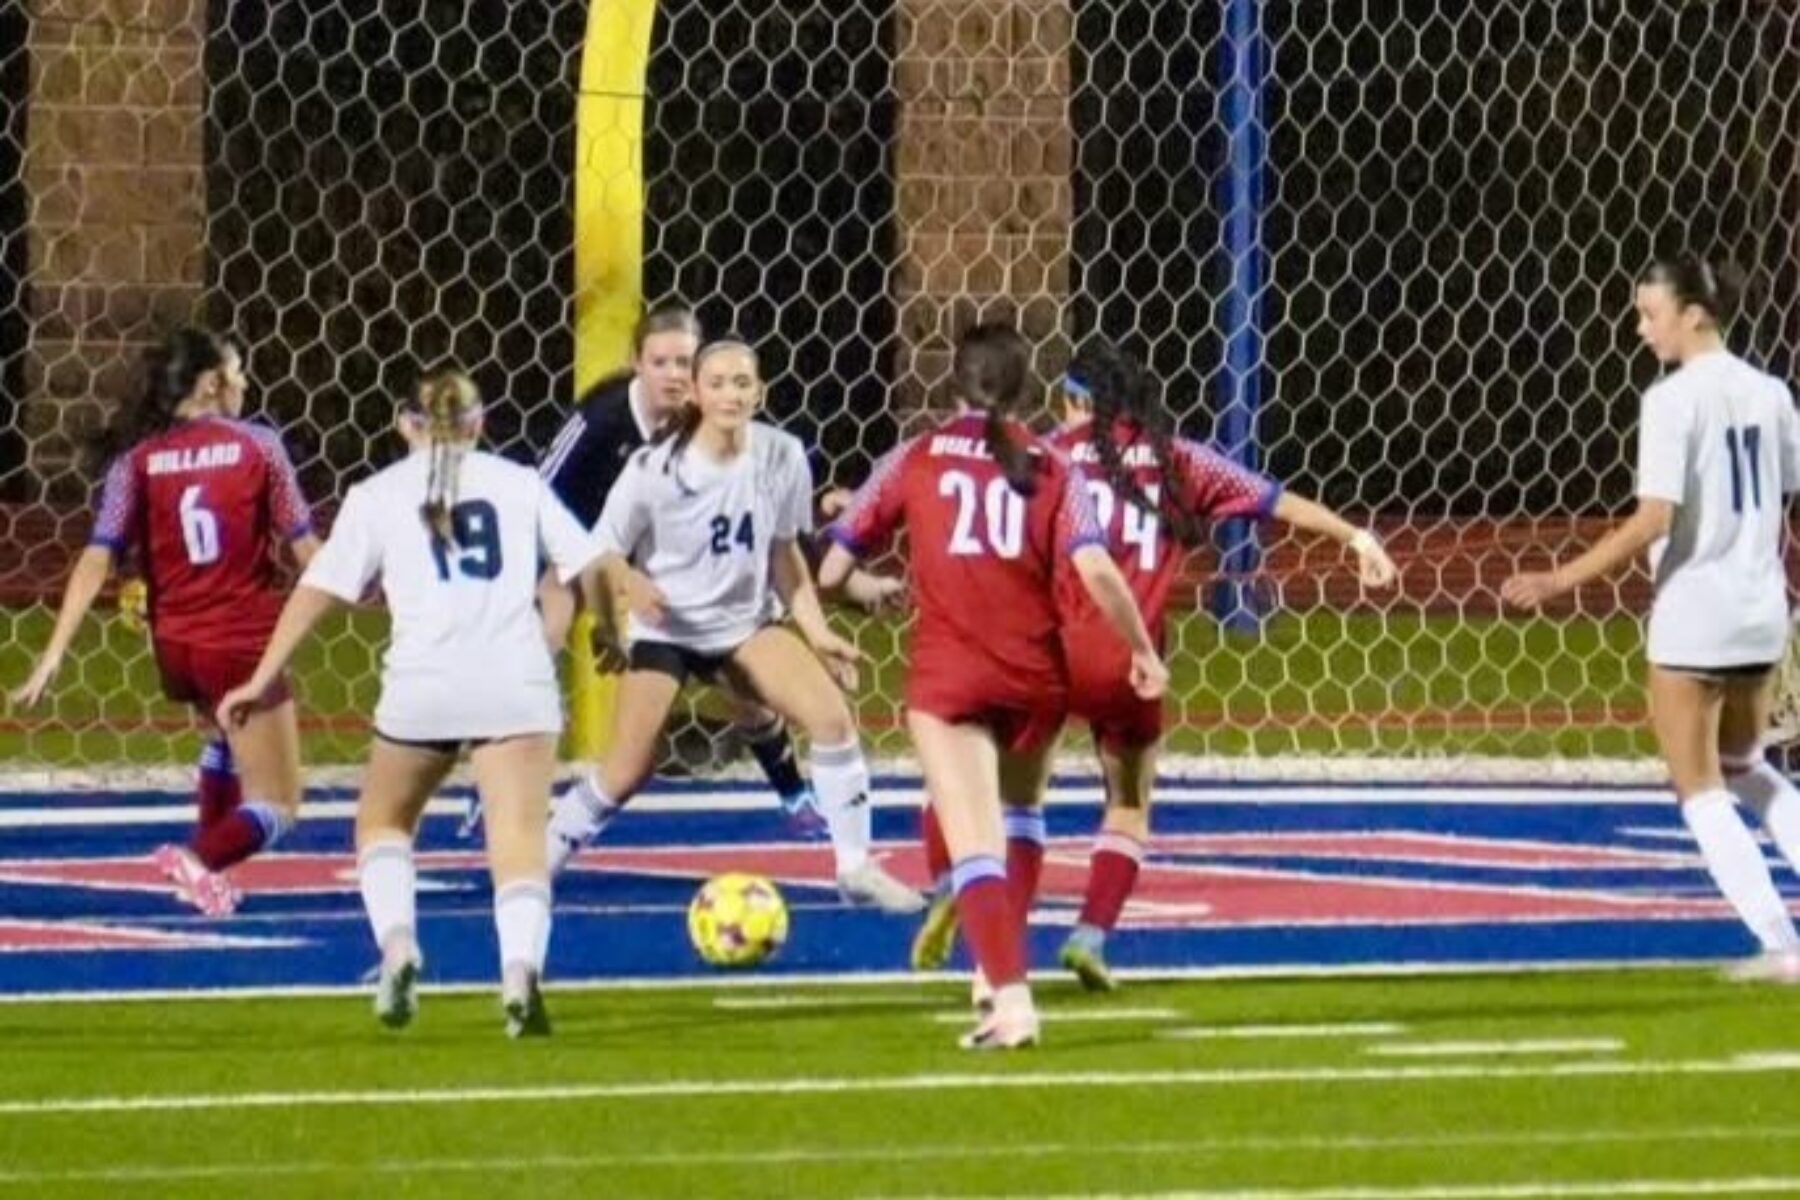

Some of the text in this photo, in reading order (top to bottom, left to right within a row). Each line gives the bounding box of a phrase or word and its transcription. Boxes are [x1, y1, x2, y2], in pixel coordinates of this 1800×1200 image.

[1726, 426, 1761, 512] 11
[179, 484, 218, 564] 6
[420, 499, 503, 580] 19
[711, 512, 754, 554] 24
[939, 470, 1024, 559] 20
